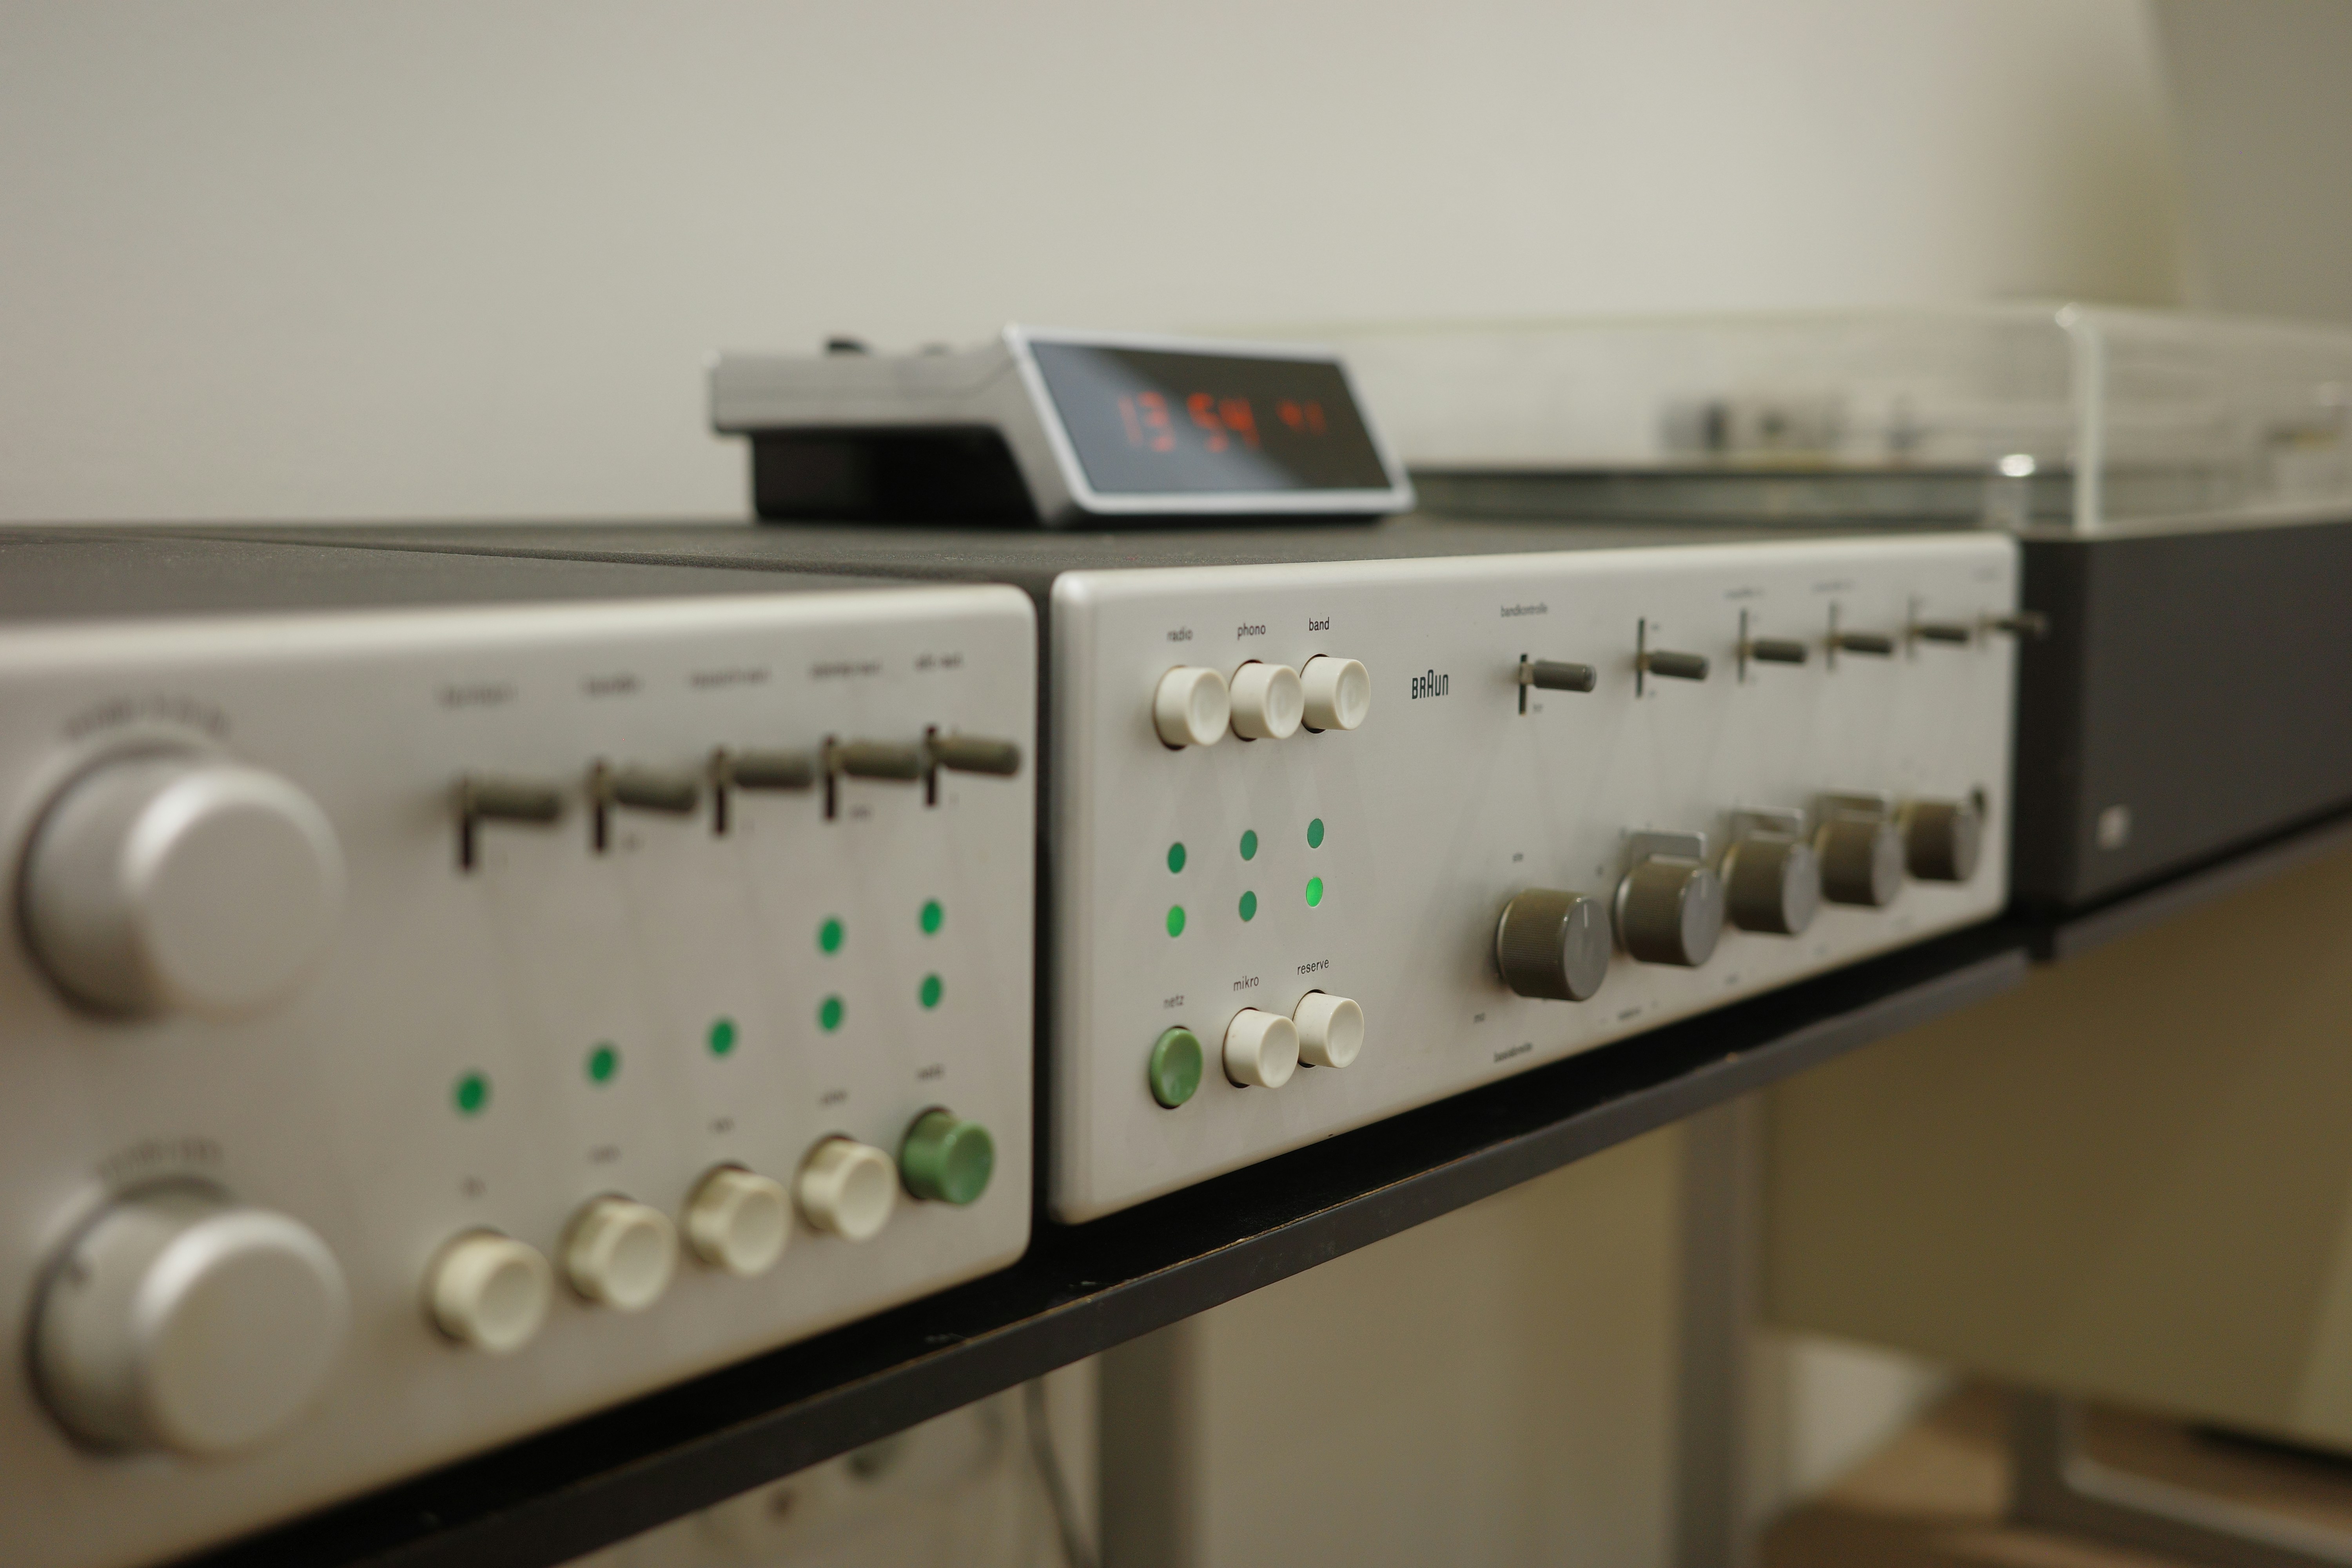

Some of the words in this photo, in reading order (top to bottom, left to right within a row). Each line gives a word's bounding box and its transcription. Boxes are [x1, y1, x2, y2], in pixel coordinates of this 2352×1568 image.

[1309, 617, 1329, 631] band
[1167, 627, 1193, 642] radio
[1237, 623, 1266, 641] phono
[1412, 669, 1448, 699] BRAUN
[1297, 959, 1329, 975] reserve
[1234, 976, 1259, 991] mikro
[1163, 995, 1184, 1009] netz
